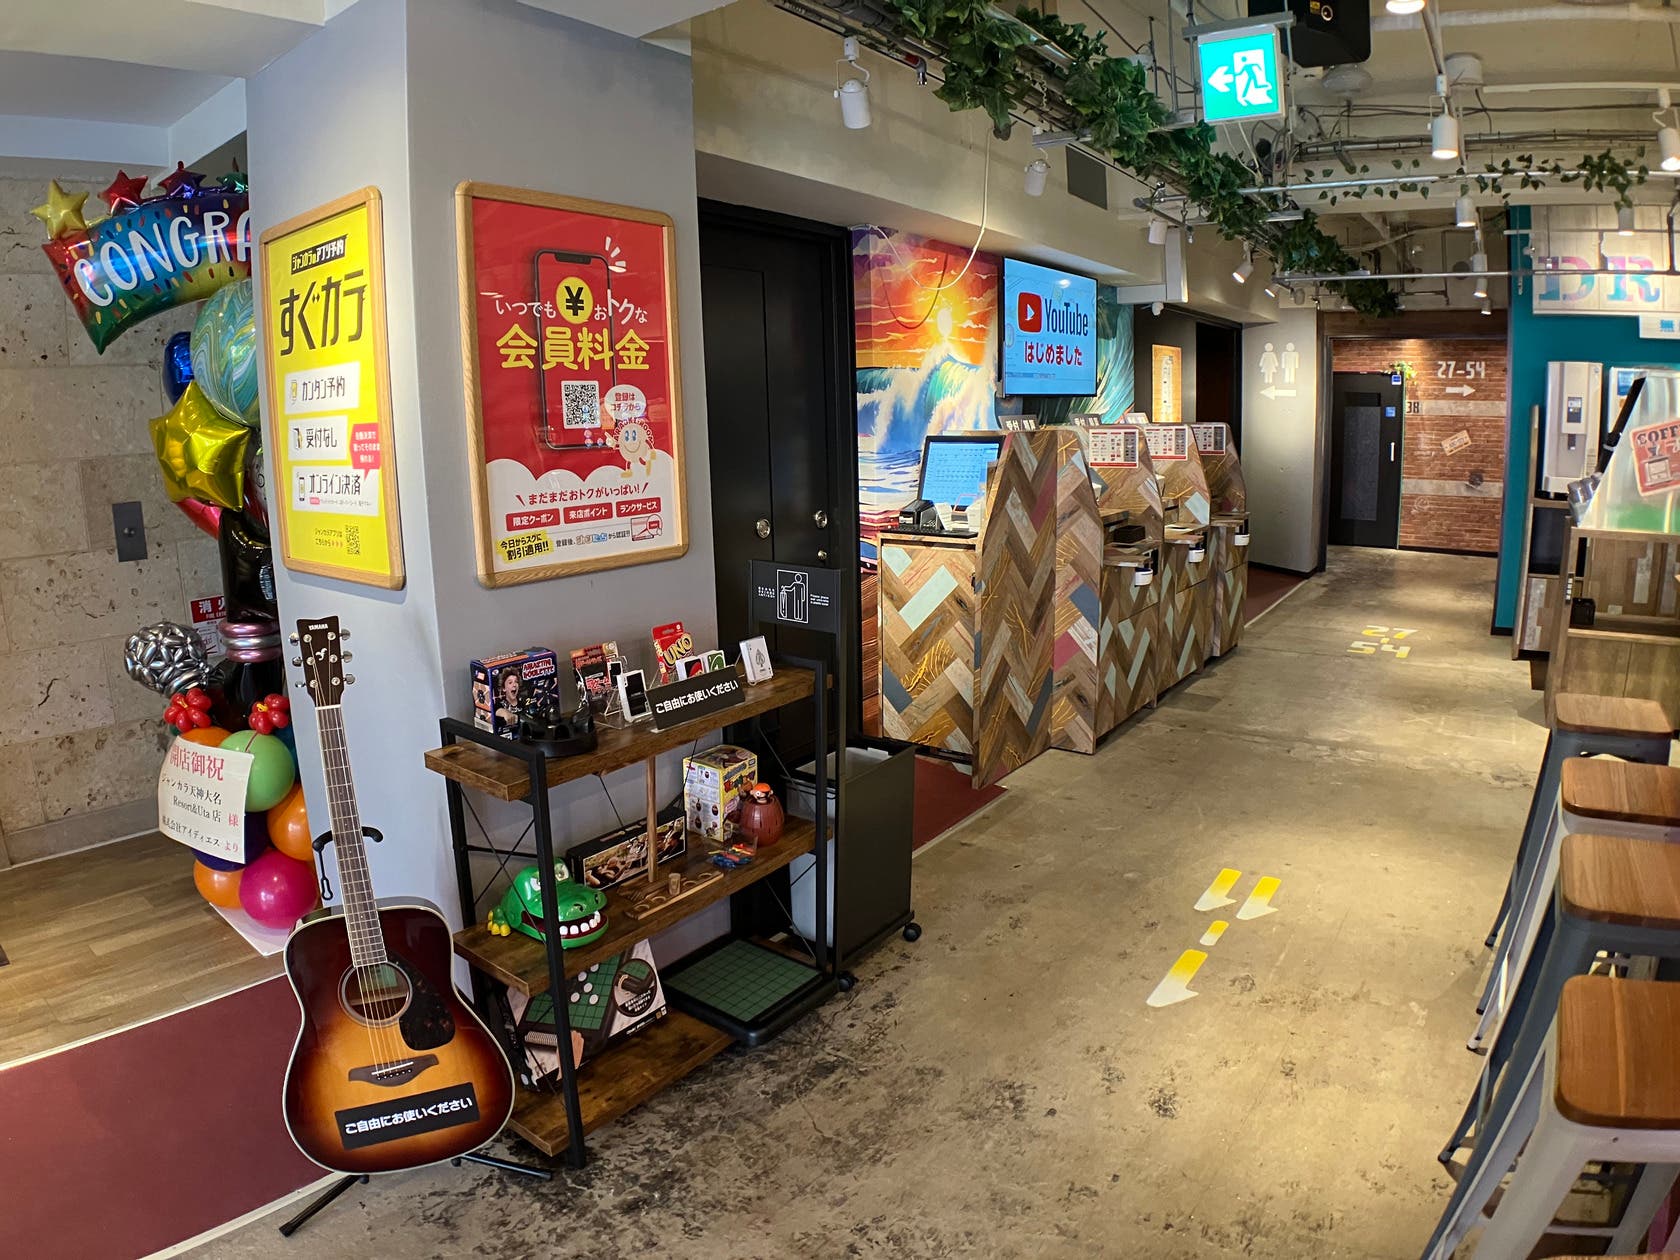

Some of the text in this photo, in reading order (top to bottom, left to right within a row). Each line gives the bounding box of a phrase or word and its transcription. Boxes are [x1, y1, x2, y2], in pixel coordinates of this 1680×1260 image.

[280, 269, 367, 356] すぐカラ
[495, 299, 557, 319] いつでも
[593, 288, 648, 324] おトクな
[1044, 298, 1088, 336] YouTube
[496, 323, 650, 370] 会員料金
[1024, 341, 1083, 366] はじめました
[1437, 360, 1486, 379] 27-54
[302, 376, 346, 401] カンタン予約
[529, 484, 640, 505] まだまだおトクがいっぱい!
[619, 500, 658, 514] ランクサービス
[513, 513, 554, 527] 限定クーポン
[500, 533, 542, 550] 今日からスグに
[506, 541, 550, 561] 割引適用!!
[308, 623, 329, 631] YAMAHA
[663, 635, 693, 666] UNO
[655, 679, 739, 714] ご自由にお使いください
[169, 744, 225, 781] 開店御祝
[345, 1097, 473, 1135] ご自由にお使いください
